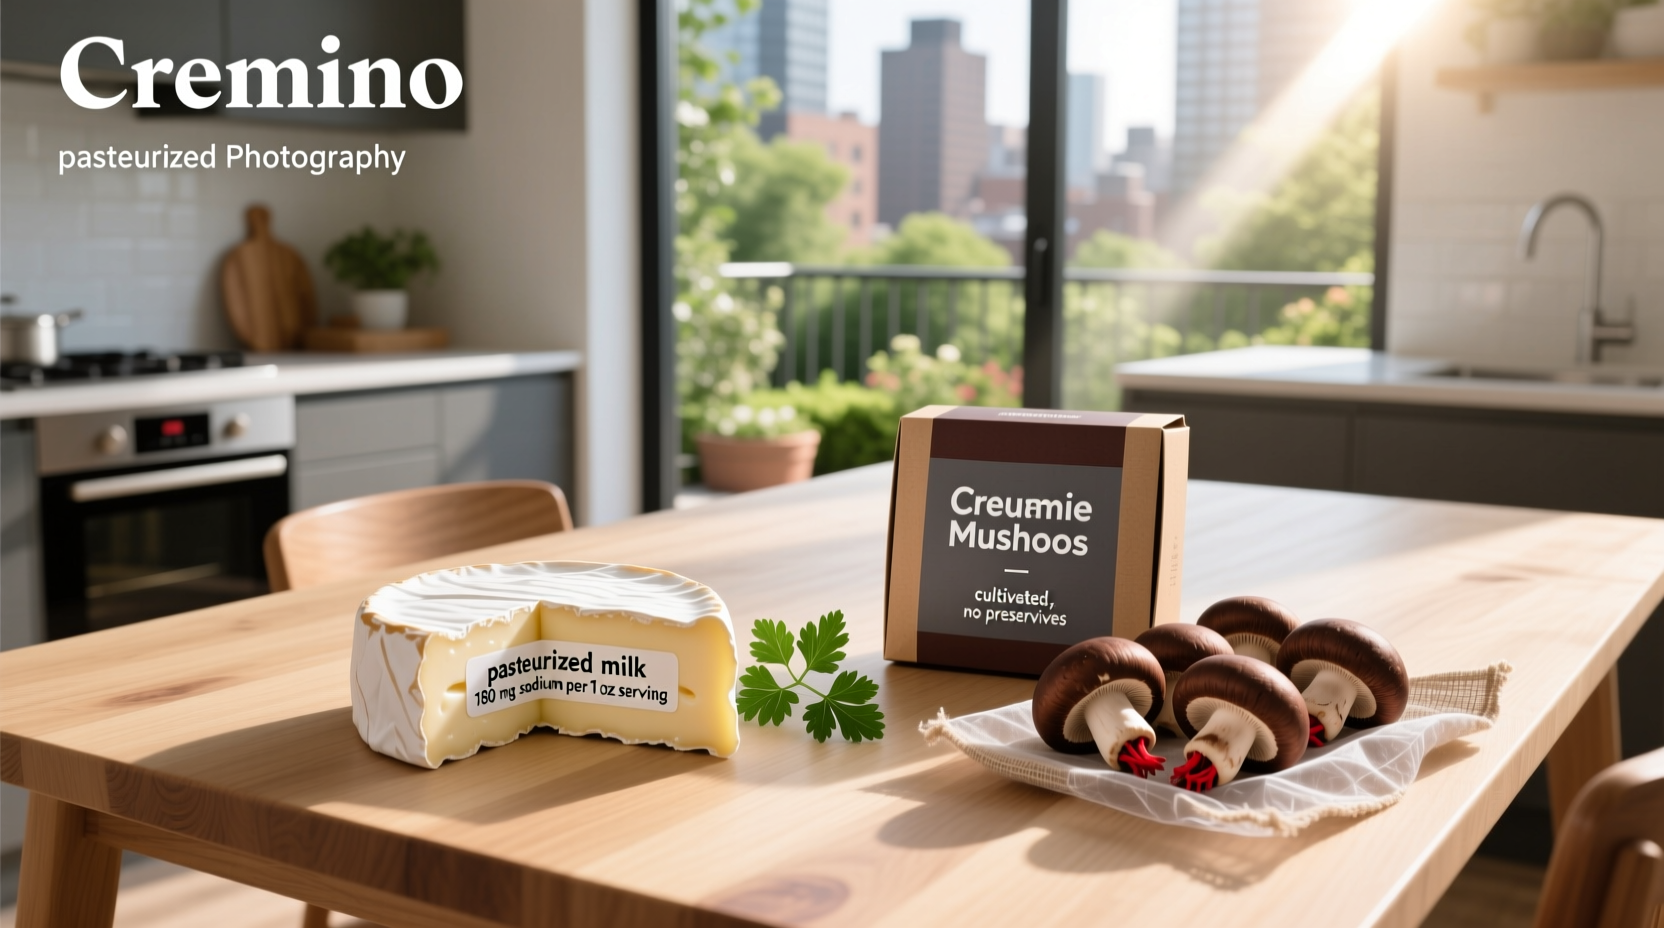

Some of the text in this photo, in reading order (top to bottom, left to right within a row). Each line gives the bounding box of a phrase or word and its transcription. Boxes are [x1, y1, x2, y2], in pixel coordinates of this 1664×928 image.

[948, 519, 1089, 556] Mushoos
[963, 607, 1067, 626] no preservives
[487, 649, 647, 688] pasteurized milk
[499, 686, 517, 702] mg
[519, 675, 564, 695] sodium
[566, 681, 588, 695] per
[590, 679, 597, 695] 1
[599, 684, 616, 696] oz
[618, 685, 668, 705] serving
